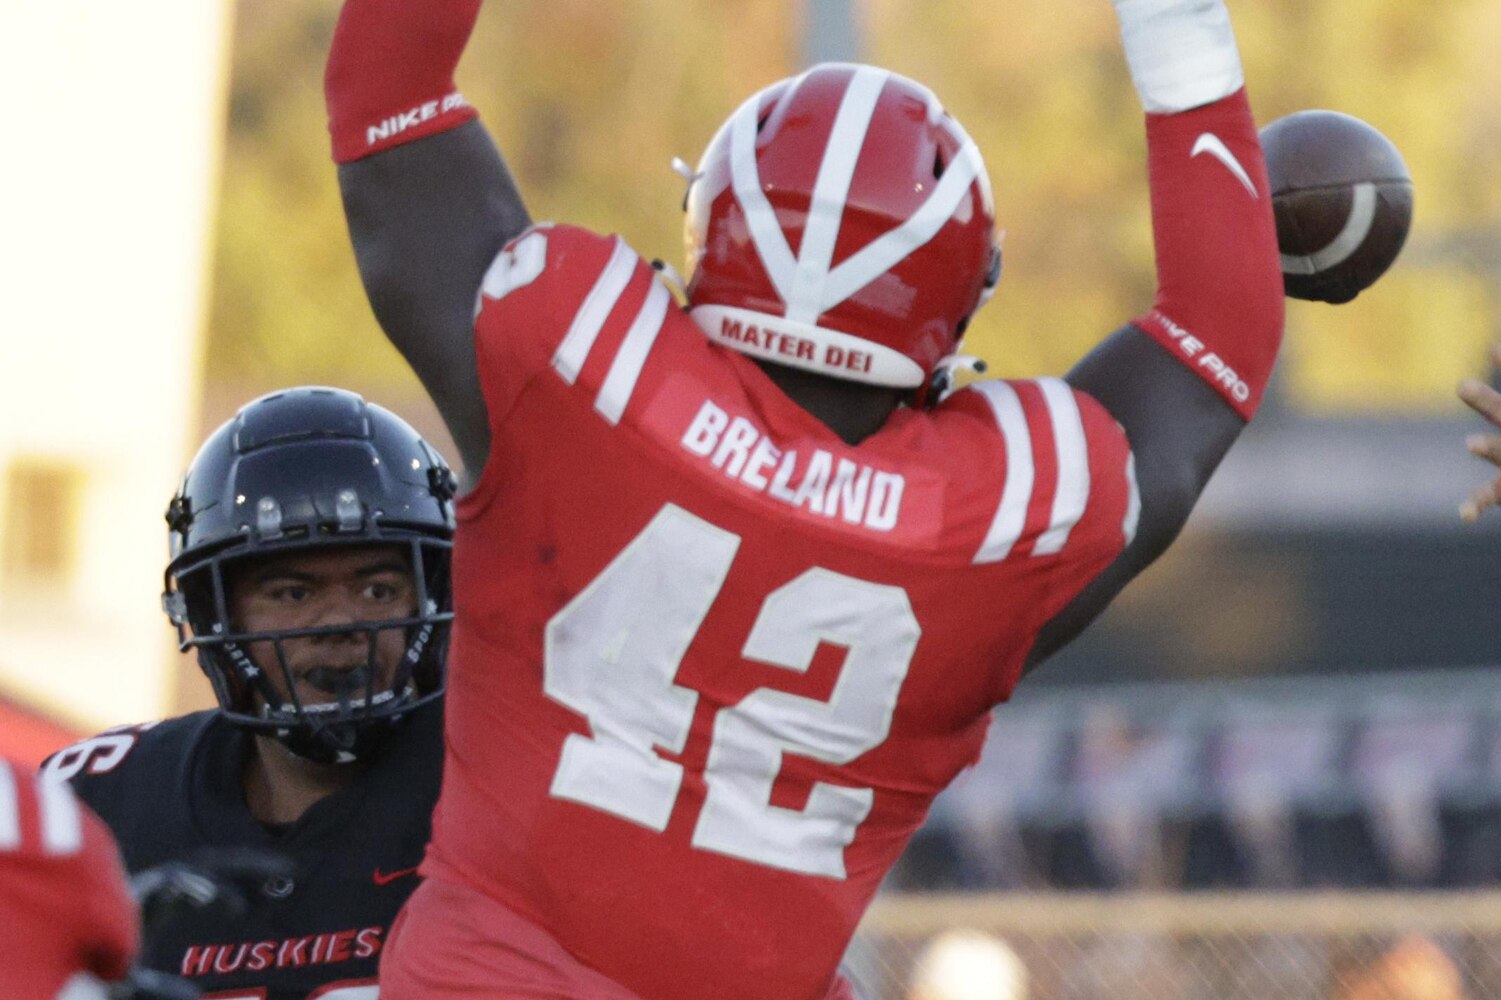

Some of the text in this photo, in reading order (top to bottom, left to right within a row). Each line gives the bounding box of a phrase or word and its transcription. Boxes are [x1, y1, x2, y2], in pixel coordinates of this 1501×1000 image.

[366, 100, 440, 146] NIKE
[720, 316, 874, 373] MATER DEI
[1199, 352, 1250, 403] PRO
[681, 399, 906, 533] BRELAND
[542, 500, 923, 881] 42
[181, 925, 384, 977] HUSKIES
